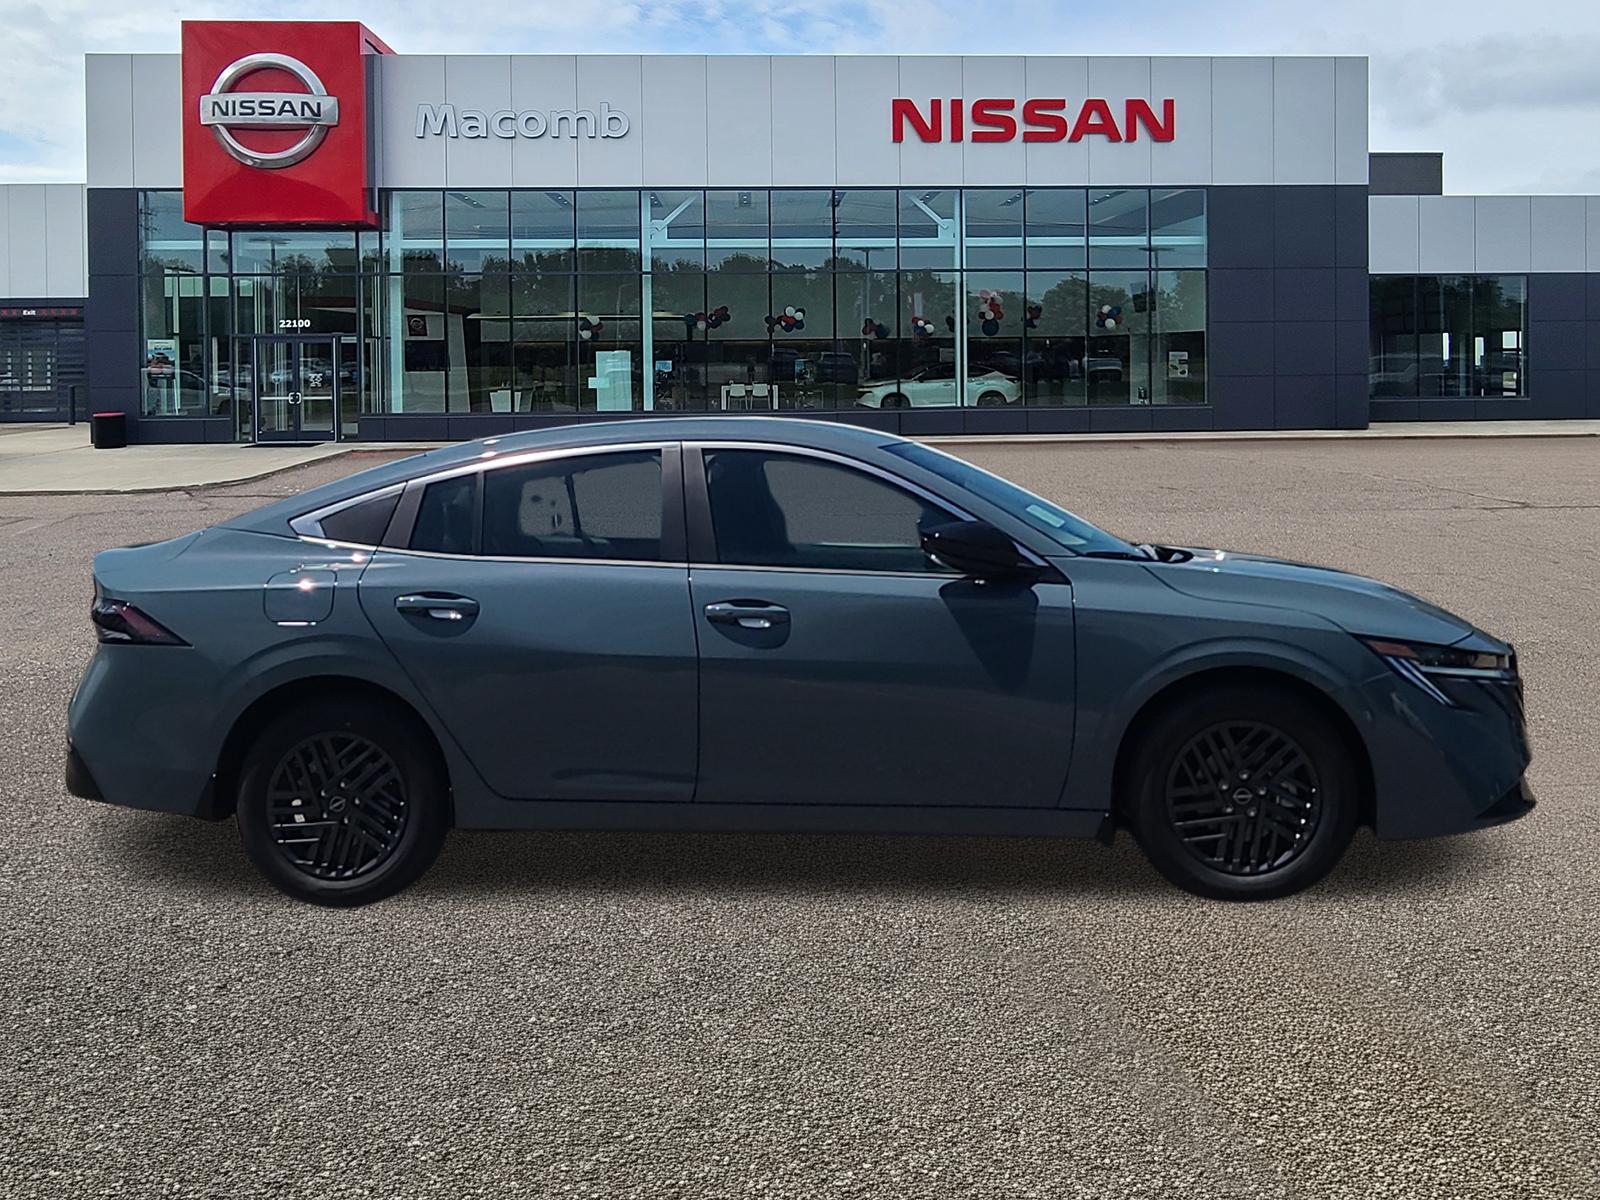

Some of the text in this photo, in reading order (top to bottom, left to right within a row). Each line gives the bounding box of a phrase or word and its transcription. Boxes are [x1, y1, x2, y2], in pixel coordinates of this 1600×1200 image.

[211, 99, 322, 119] NISSAN
[415, 102, 630, 139] Macomb
[891, 98, 1175, 143] NISSAN
[279, 319, 311, 328] 22100
